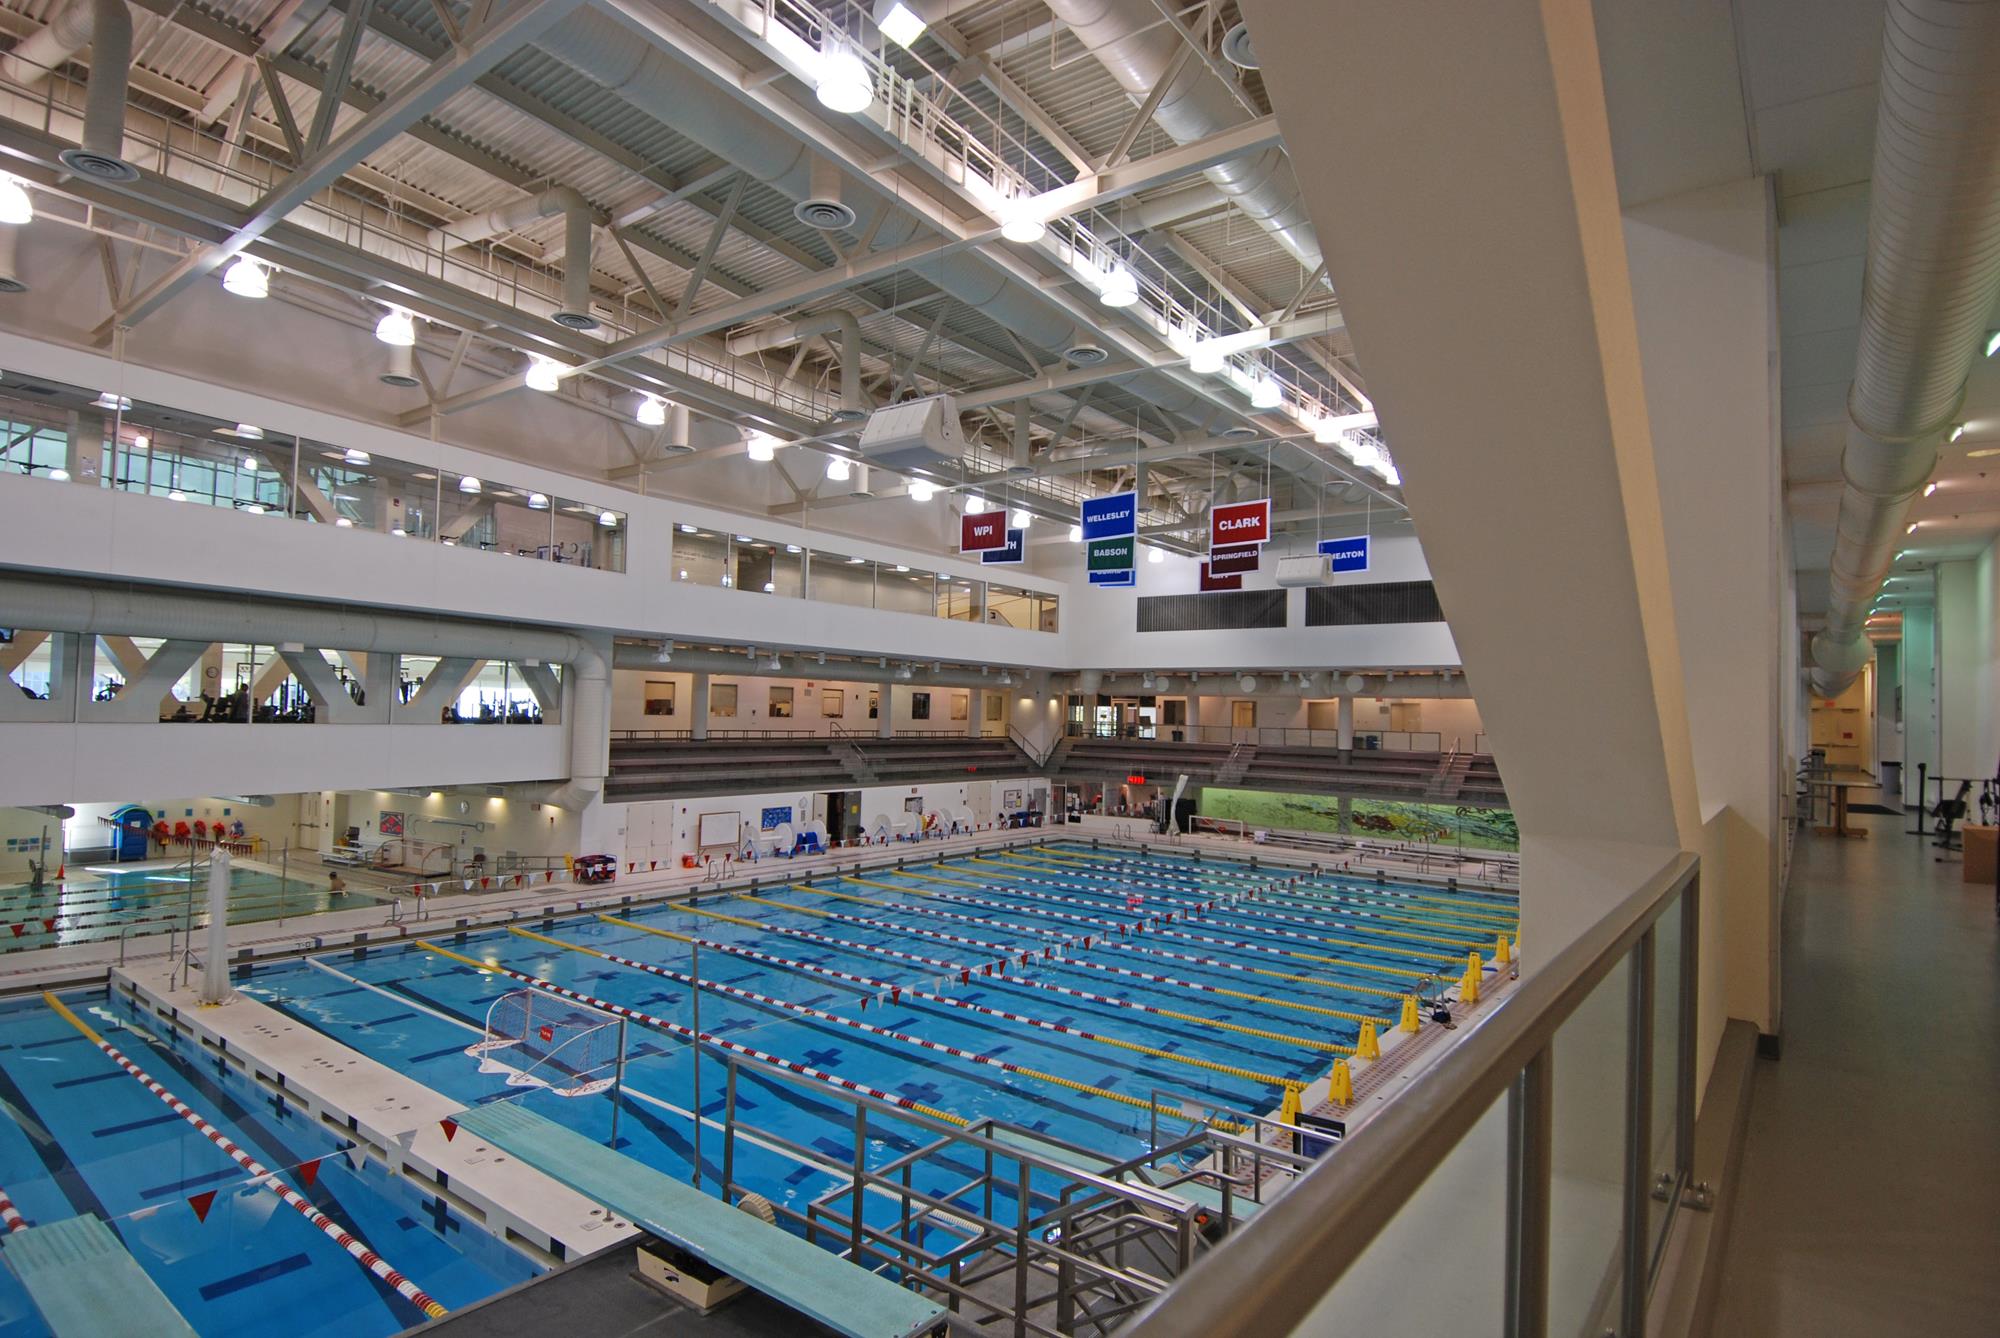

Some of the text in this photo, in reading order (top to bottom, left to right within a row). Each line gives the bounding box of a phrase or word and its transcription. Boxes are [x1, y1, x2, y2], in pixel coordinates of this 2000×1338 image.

[1087, 510, 1130, 523] WELLESLEY
[1219, 516, 1261, 531] CLARK
[974, 525, 993, 537] WPI
[1094, 548, 1128, 557] BABSON
[1213, 550, 1258, 561] SPRINGFIELD
[1333, 550, 1364, 560] EATON
